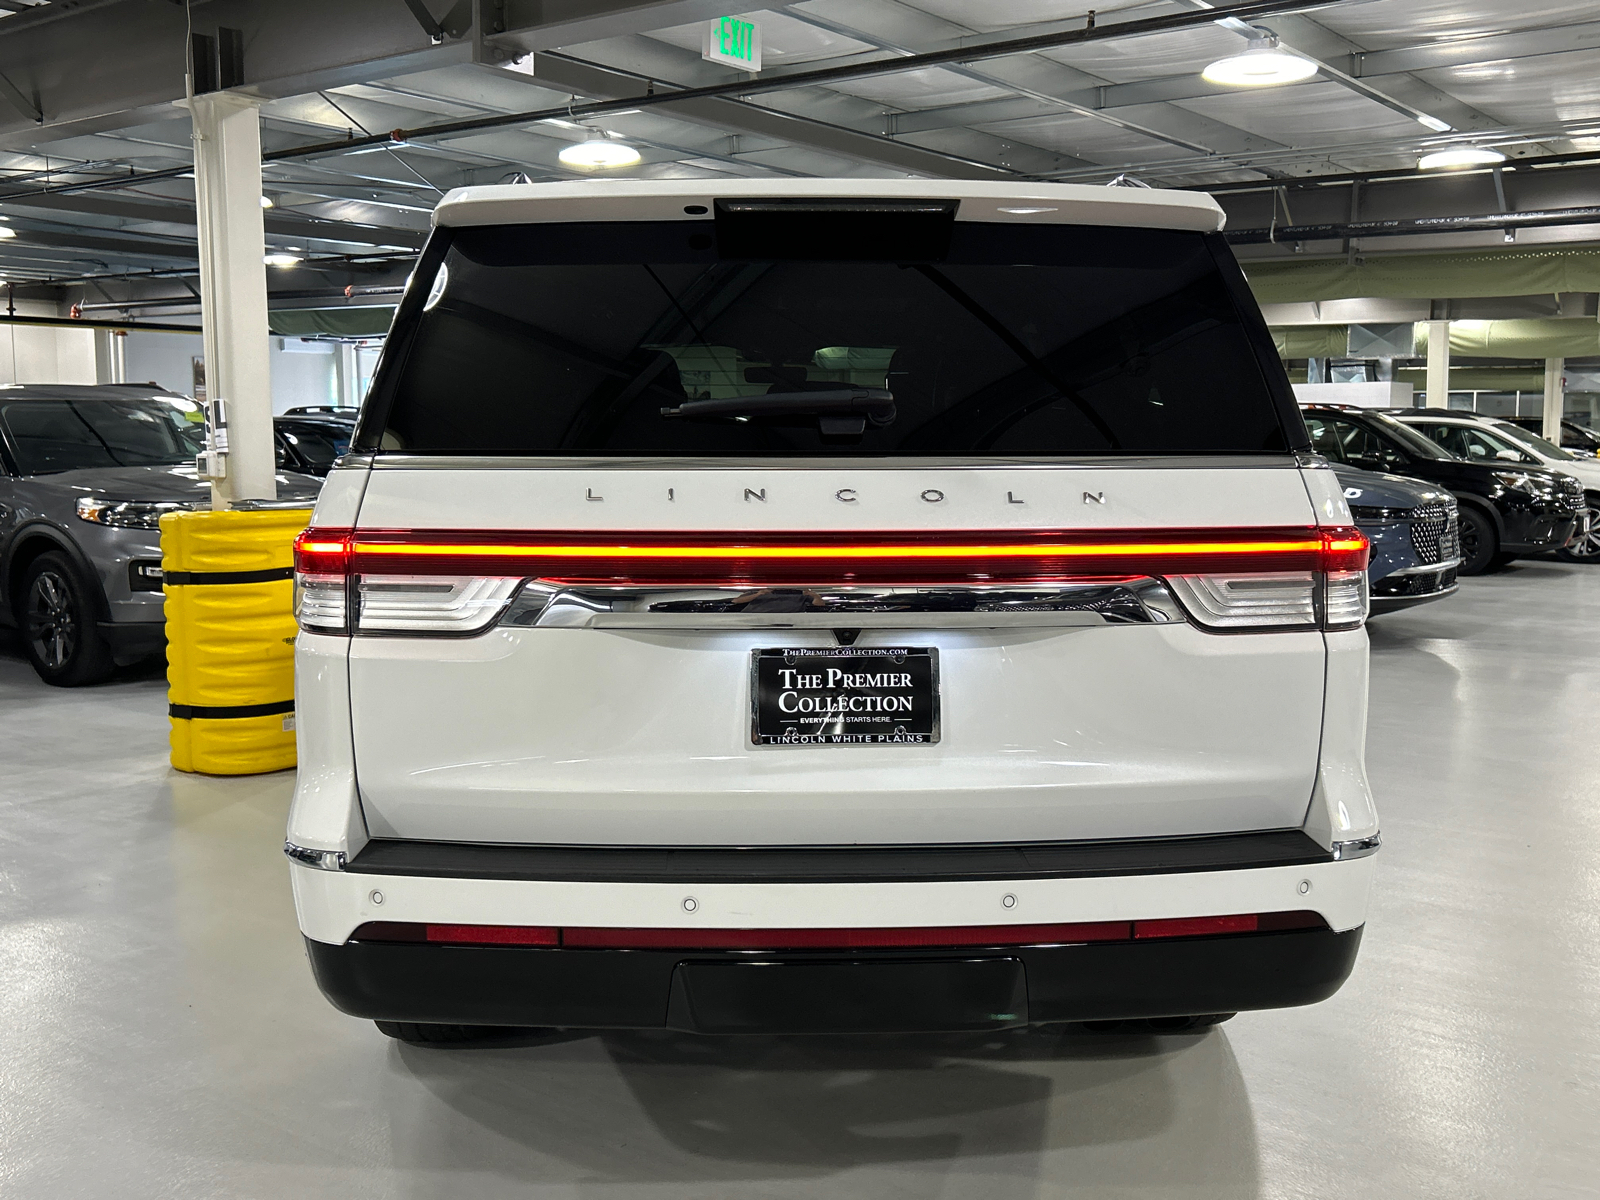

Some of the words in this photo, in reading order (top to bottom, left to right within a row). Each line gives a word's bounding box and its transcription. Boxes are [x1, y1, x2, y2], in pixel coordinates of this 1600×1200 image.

[720, 16, 755, 61] EXIT
[585, 487, 1106, 505] LINCOLN
[778, 668, 823, 690] THE
[826, 667, 914, 690] PREMIER
[778, 690, 914, 713] COLLECTION
[770, 735, 826, 744] LINCOLN
[831, 735, 872, 743] WHITE
[878, 734, 923, 743] PLAINS
